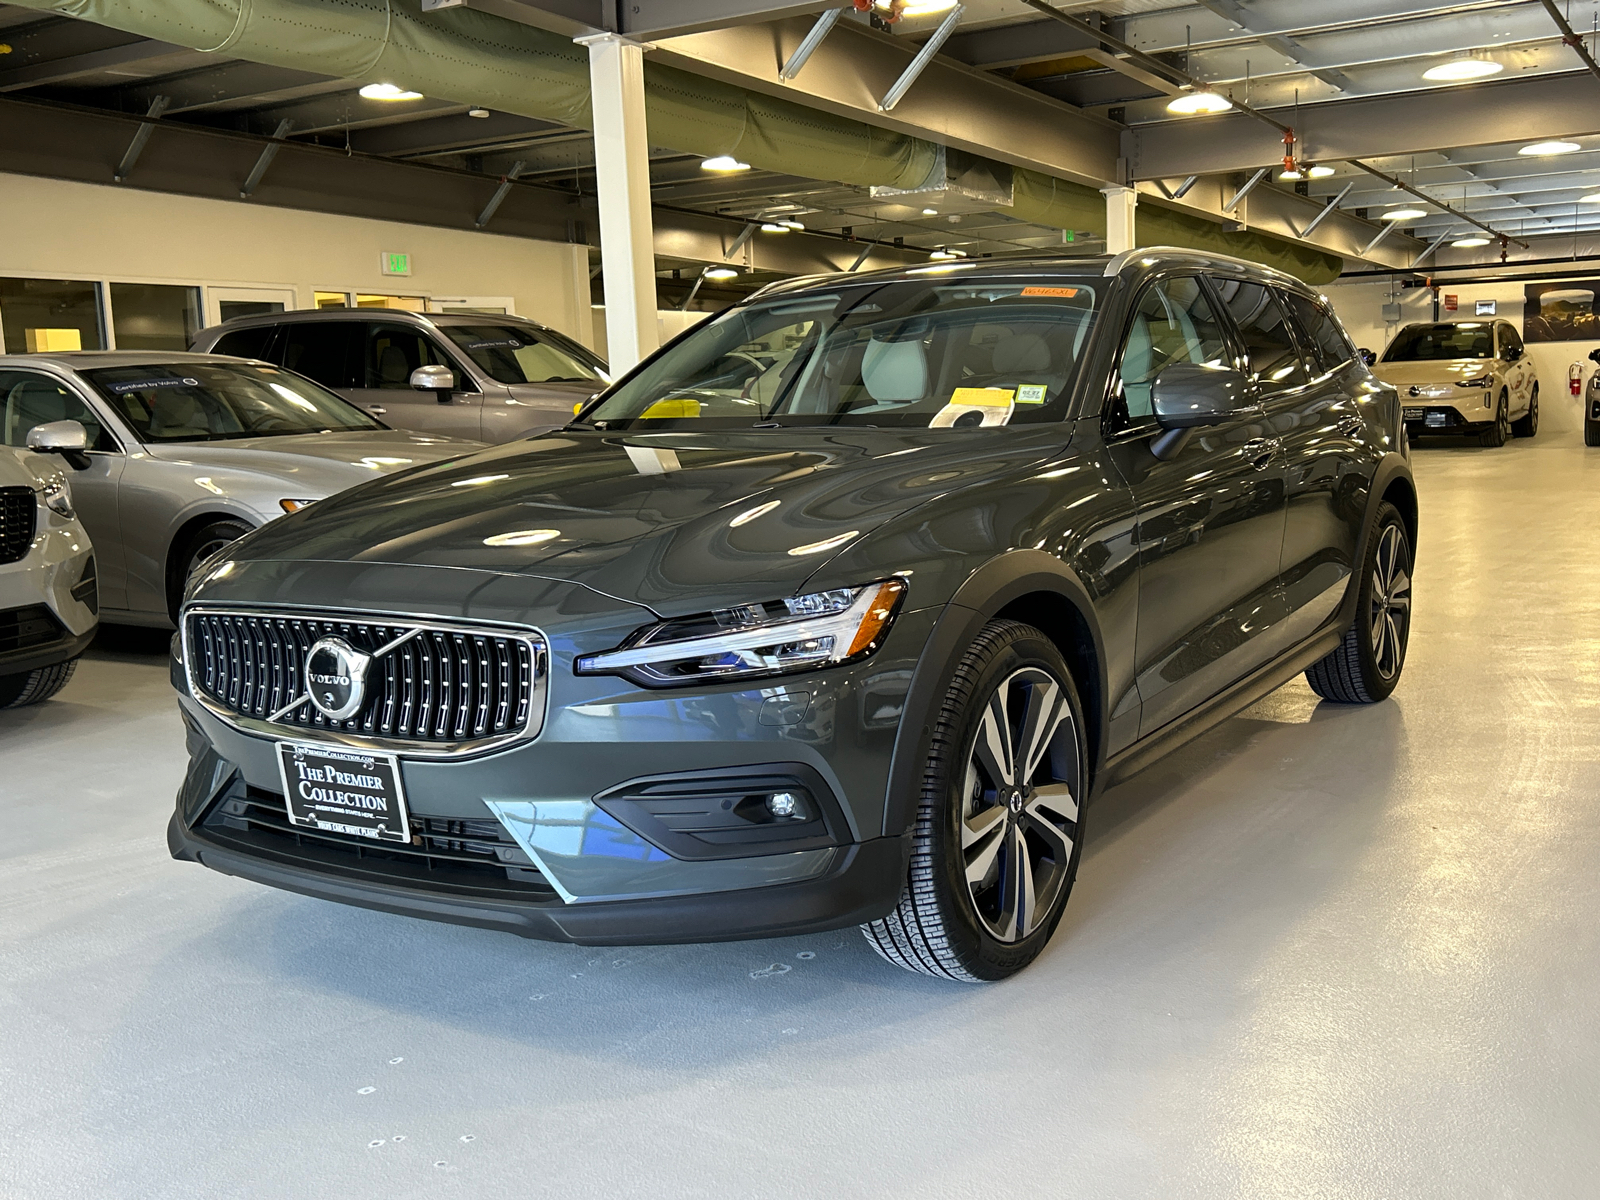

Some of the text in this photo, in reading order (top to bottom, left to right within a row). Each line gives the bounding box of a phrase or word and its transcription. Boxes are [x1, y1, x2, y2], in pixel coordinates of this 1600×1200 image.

[115, 382, 147, 391] Certified
[309, 673, 350, 686] VOLVO
[294, 761, 385, 790] THE PREMIER
[298, 781, 388, 811] COLLECTION
